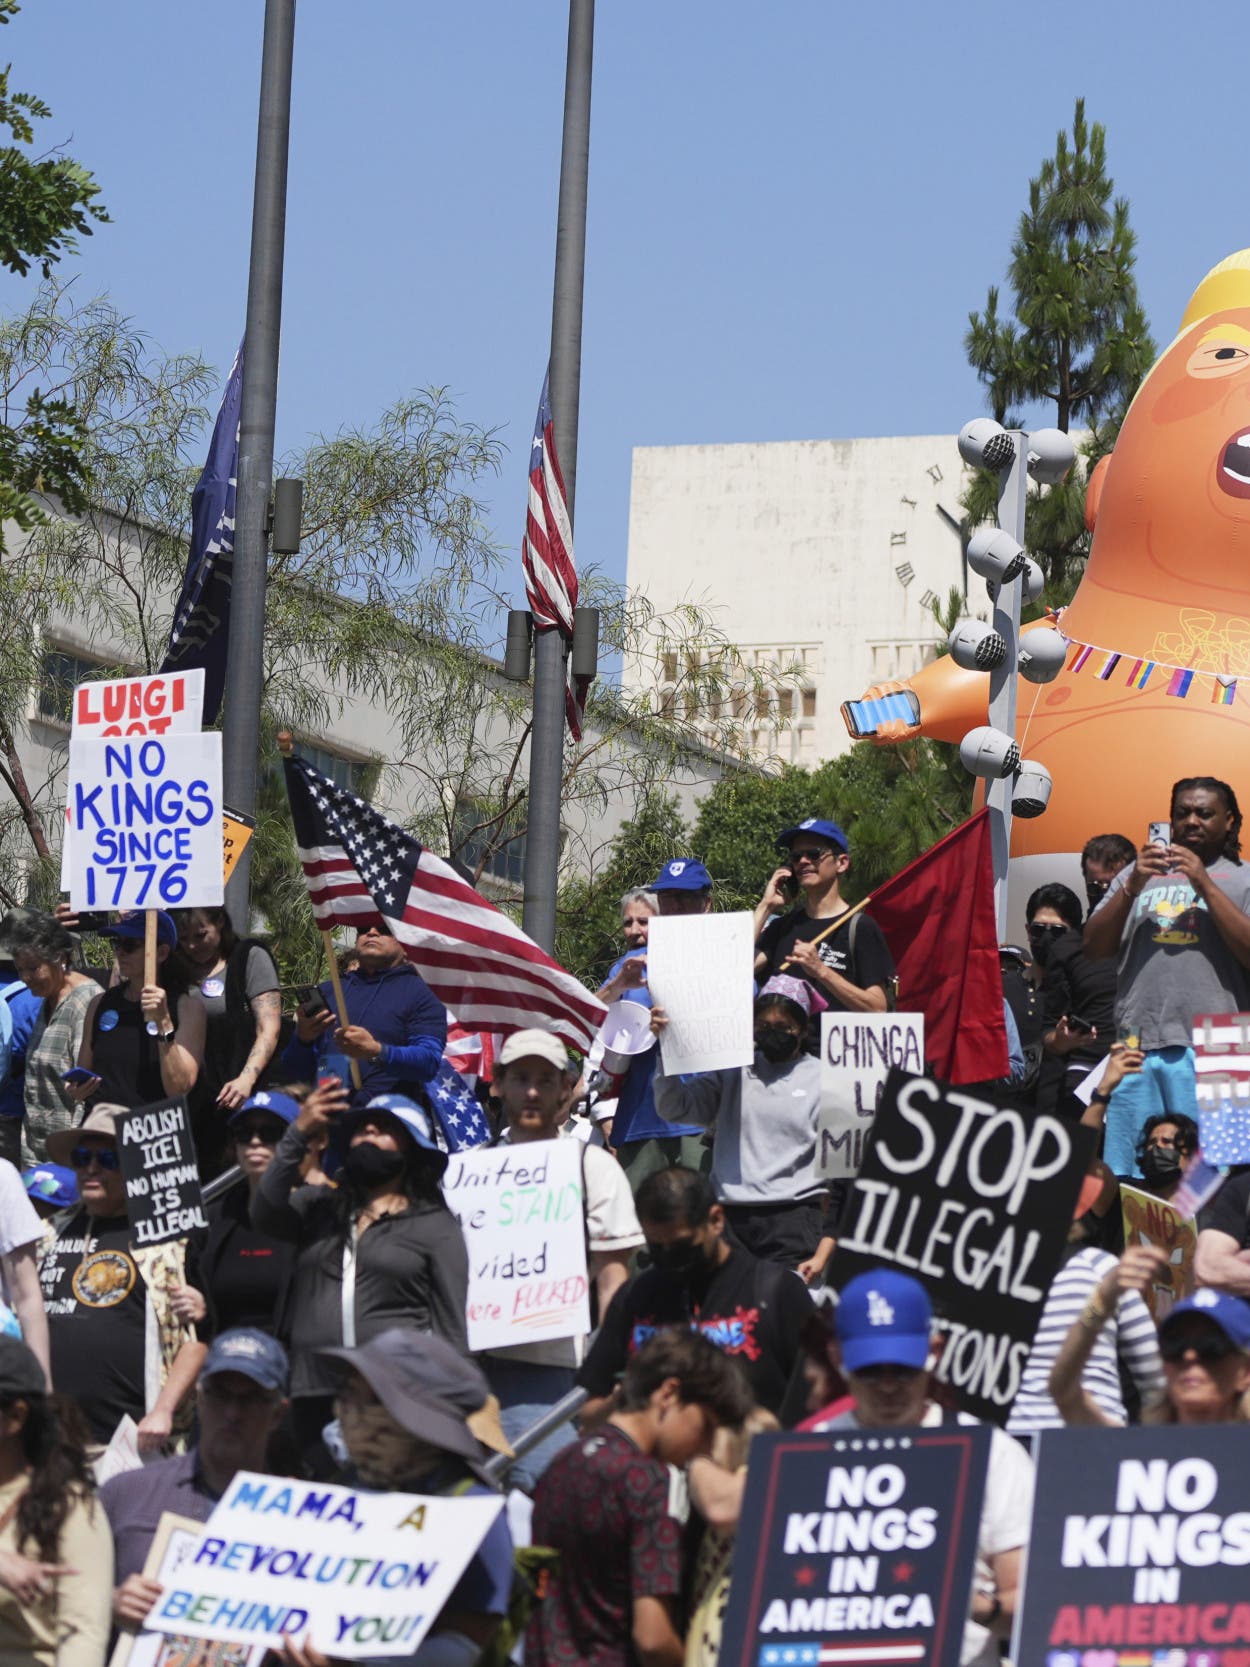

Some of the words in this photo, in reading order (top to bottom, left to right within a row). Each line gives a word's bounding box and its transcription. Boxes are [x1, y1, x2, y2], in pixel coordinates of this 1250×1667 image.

[78, 679, 184, 724] LUIGI
[105, 740, 166, 778] NO
[75, 780, 214, 830] KINGS
[92, 828, 192, 865] SINCE
[86, 863, 188, 906] 1776
[827, 1025, 922, 1072] CHINGA
[122, 1107, 185, 1146] ABOLISH
[875, 1078, 1072, 1215] STOP
[140, 1135, 182, 1169] ICE!
[126, 1176, 149, 1198] NO
[151, 1164, 199, 1192] HUMAN
[151, 1188, 181, 1216] IS
[135, 1206, 209, 1243] ILLEGAL
[499, 1181, 583, 1227] STAND
[837, 1177, 1043, 1303] ILLEGAL
[866, 1290, 895, 1326] LA
[230, 1481, 366, 1532] MAMA,
[397, 1503, 428, 1531] A
[826, 1463, 906, 1508] NO
[1116, 1458, 1218, 1512] NO
[783, 1507, 938, 1554] KINGS
[194, 1537, 439, 1590] REVOLUTION
[828, 1556, 879, 1593] IN
[1133, 1568, 1181, 1603] IN
[160, 1590, 309, 1636] BEHIND
[334, 1614, 426, 1644] YOU!
[759, 1594, 935, 1634] AMERICA
